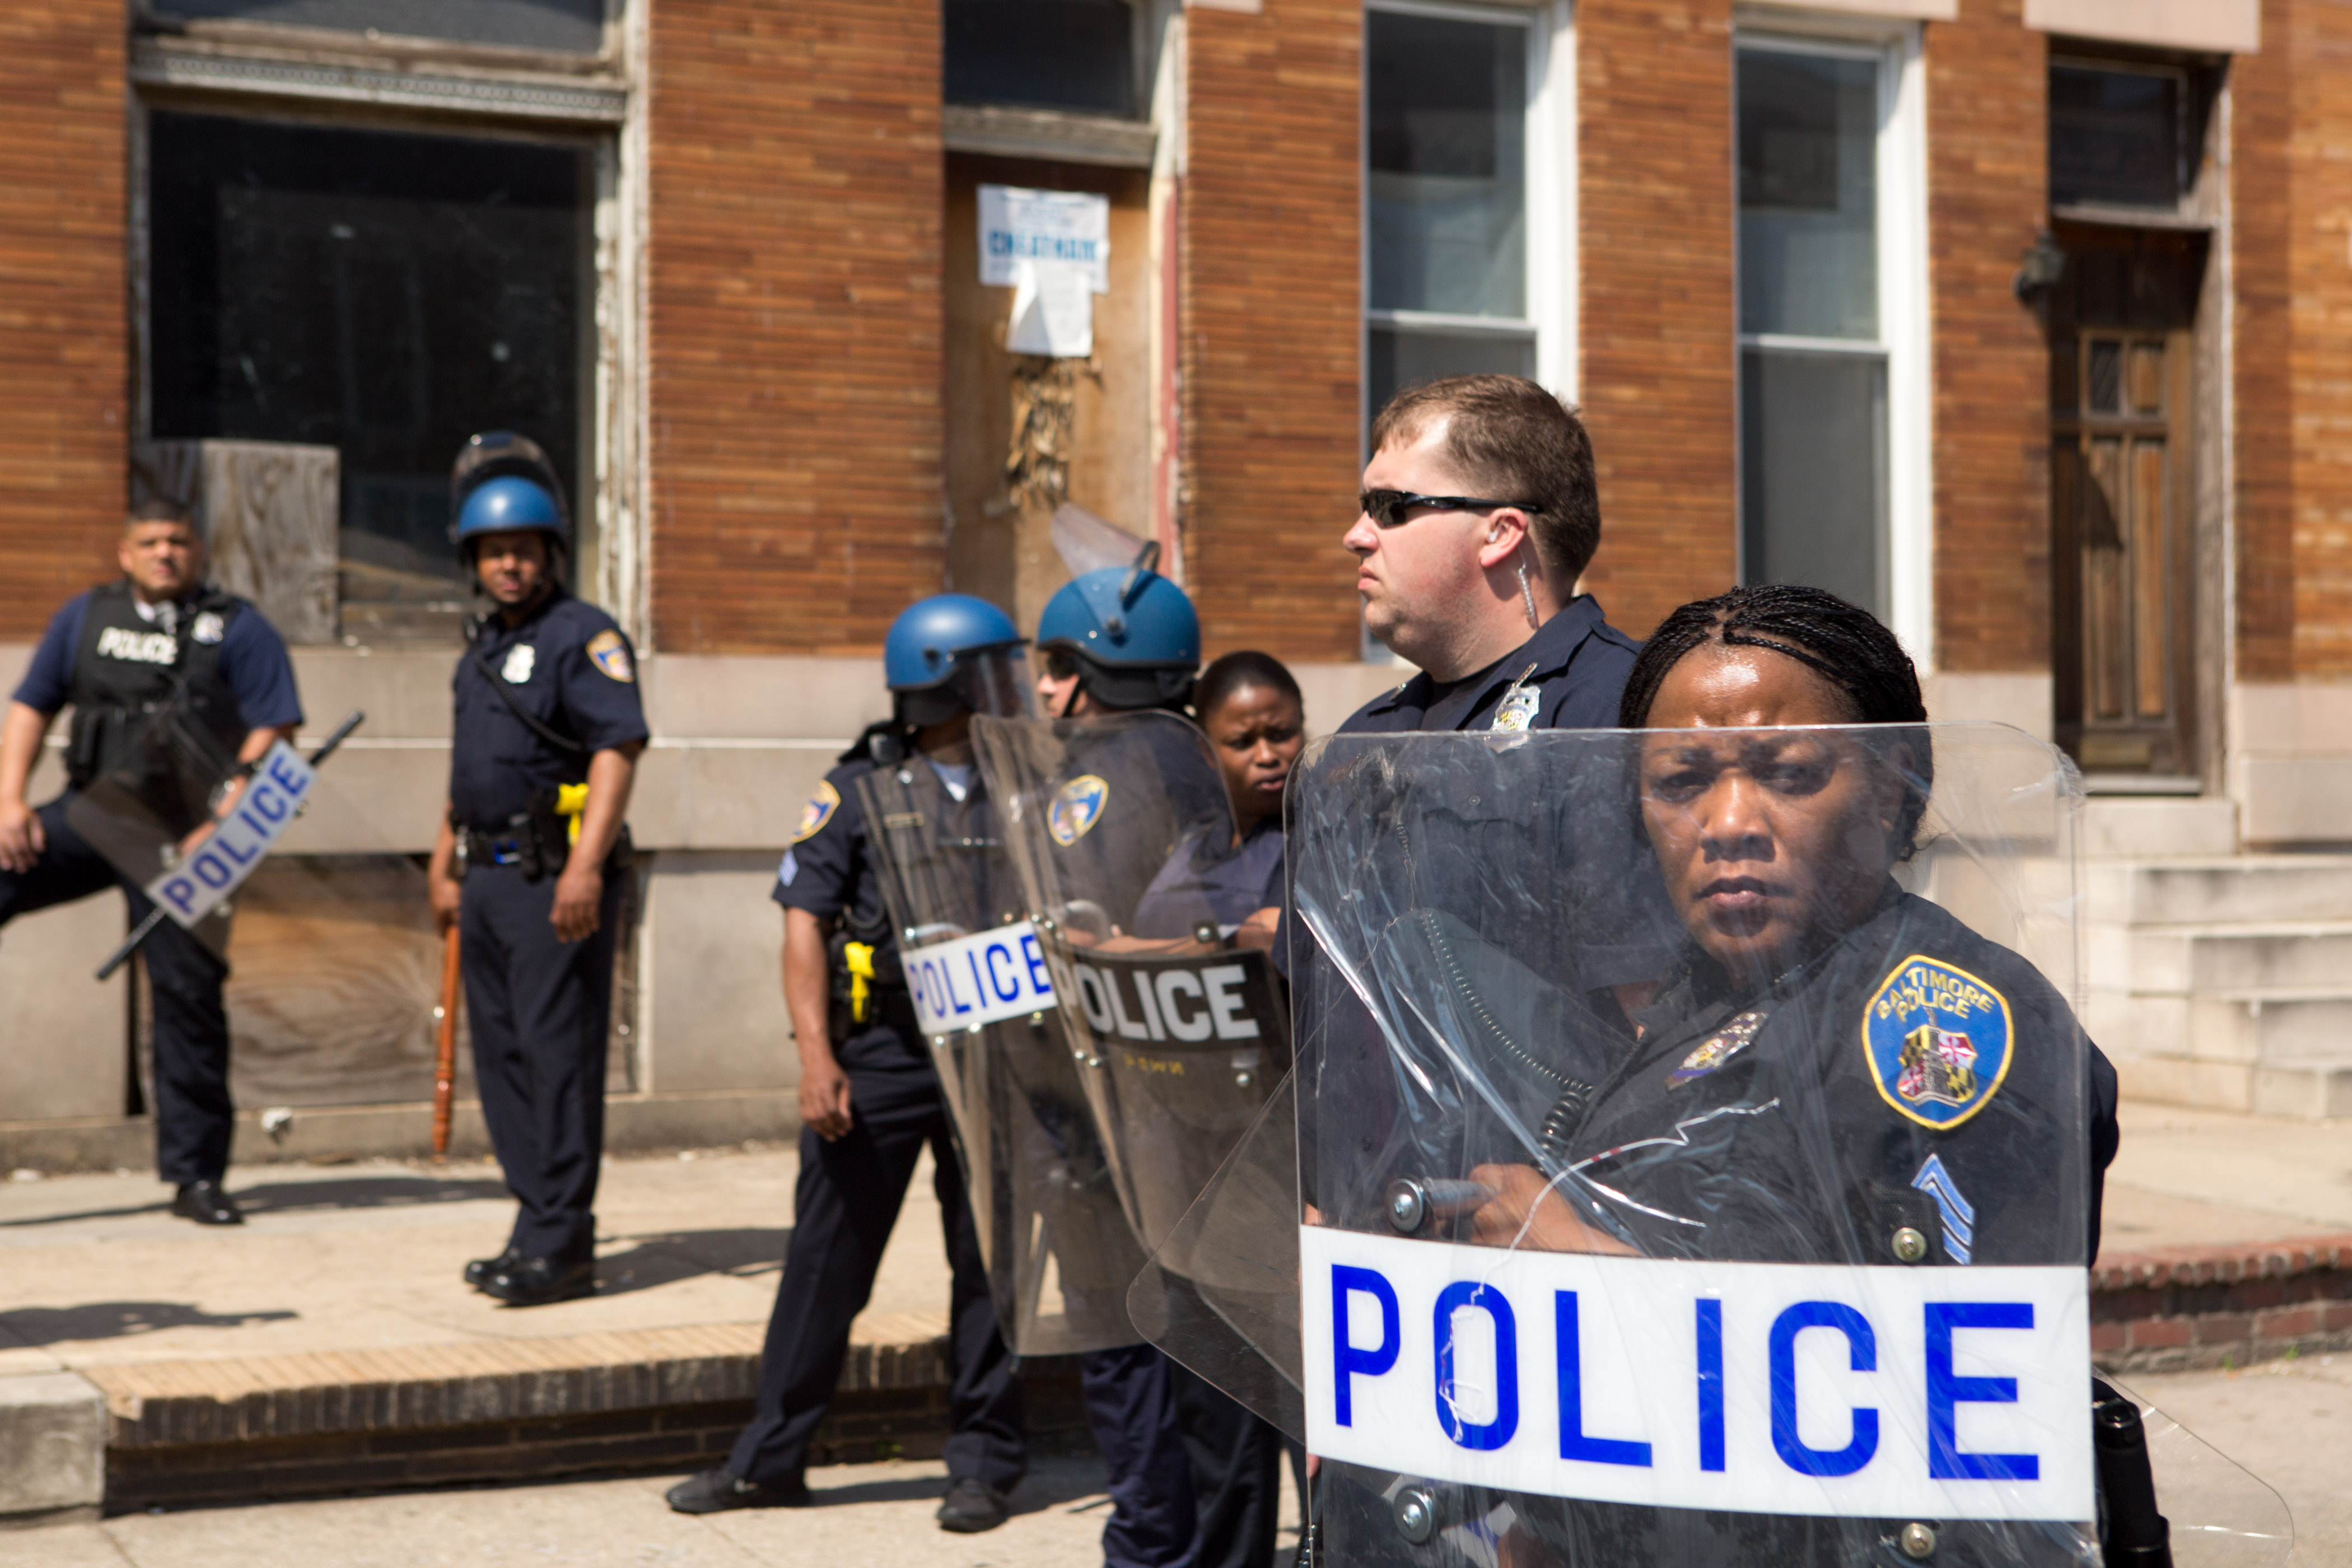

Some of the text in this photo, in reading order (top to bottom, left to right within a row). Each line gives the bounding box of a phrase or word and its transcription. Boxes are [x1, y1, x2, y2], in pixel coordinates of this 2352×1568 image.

[97, 627, 178, 665] POLICE
[162, 753, 309, 916] POLICE
[908, 934, 1051, 1021] POLICE
[1877, 967, 1996, 1020] BALTIMORE
[1895, 986, 1971, 1023] POLICE
[1331, 1264, 2040, 1481] POLICE
